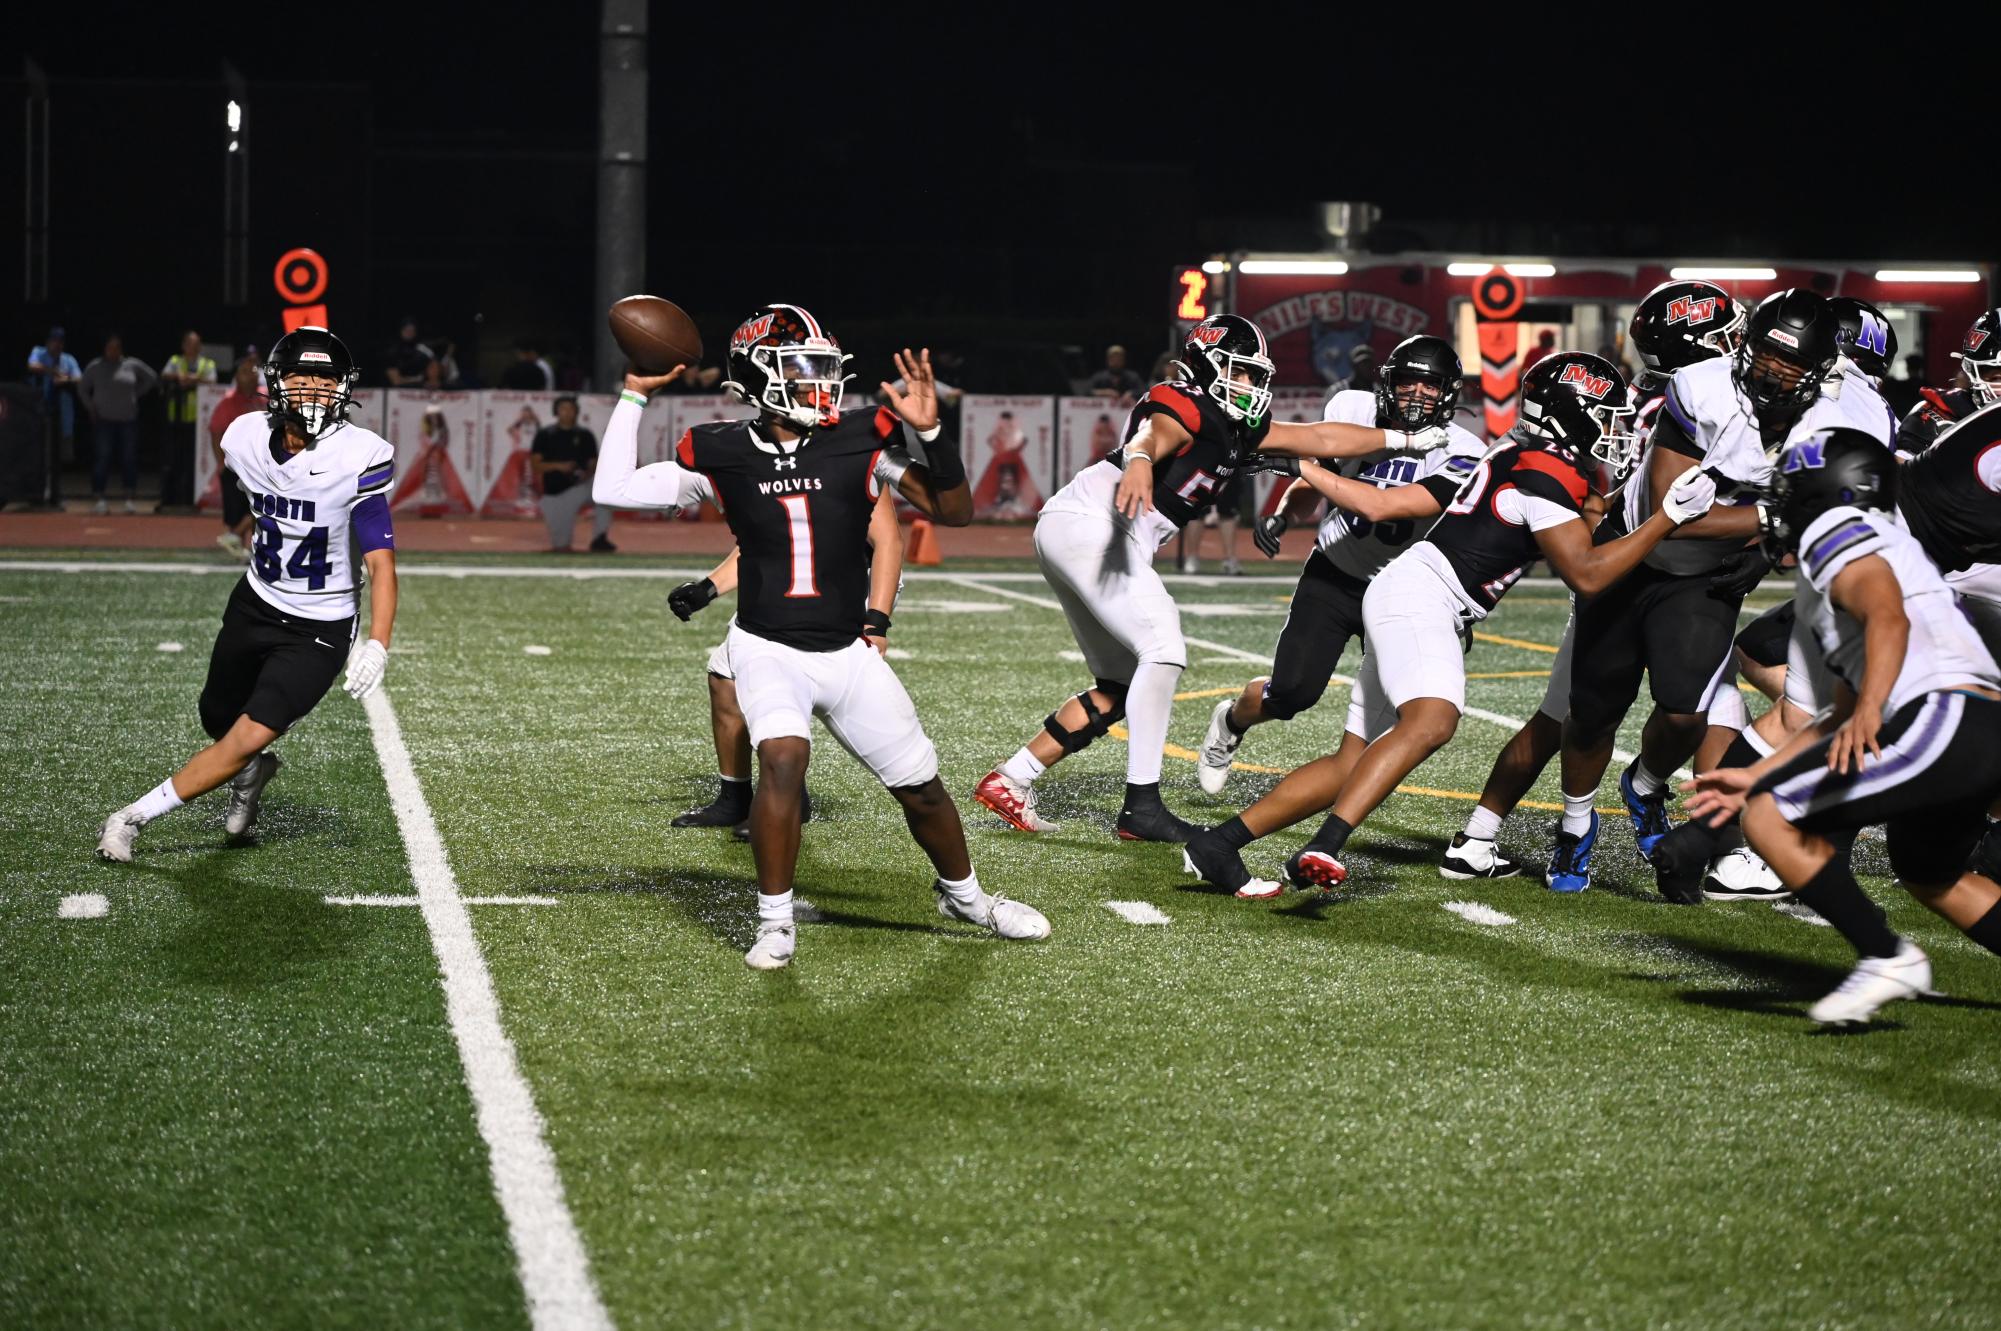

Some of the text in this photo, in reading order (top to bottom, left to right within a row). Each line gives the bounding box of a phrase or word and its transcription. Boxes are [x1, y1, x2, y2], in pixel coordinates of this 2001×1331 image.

[1178, 270, 1206, 319] 2
[1667, 295, 1715, 326] NW
[1186, 322, 1228, 346] NW
[1254, 291, 1428, 340] NILES WEST
[1855, 309, 1888, 357] N
[1771, 330, 1796, 345] Riddell
[1558, 363, 1614, 399] NW
[1783, 430, 1836, 474] N
[759, 478, 822, 495] WOLVES
[252, 493, 316, 522] NORTH
[255, 515, 333, 591] 84
[776, 494, 822, 598] 1
